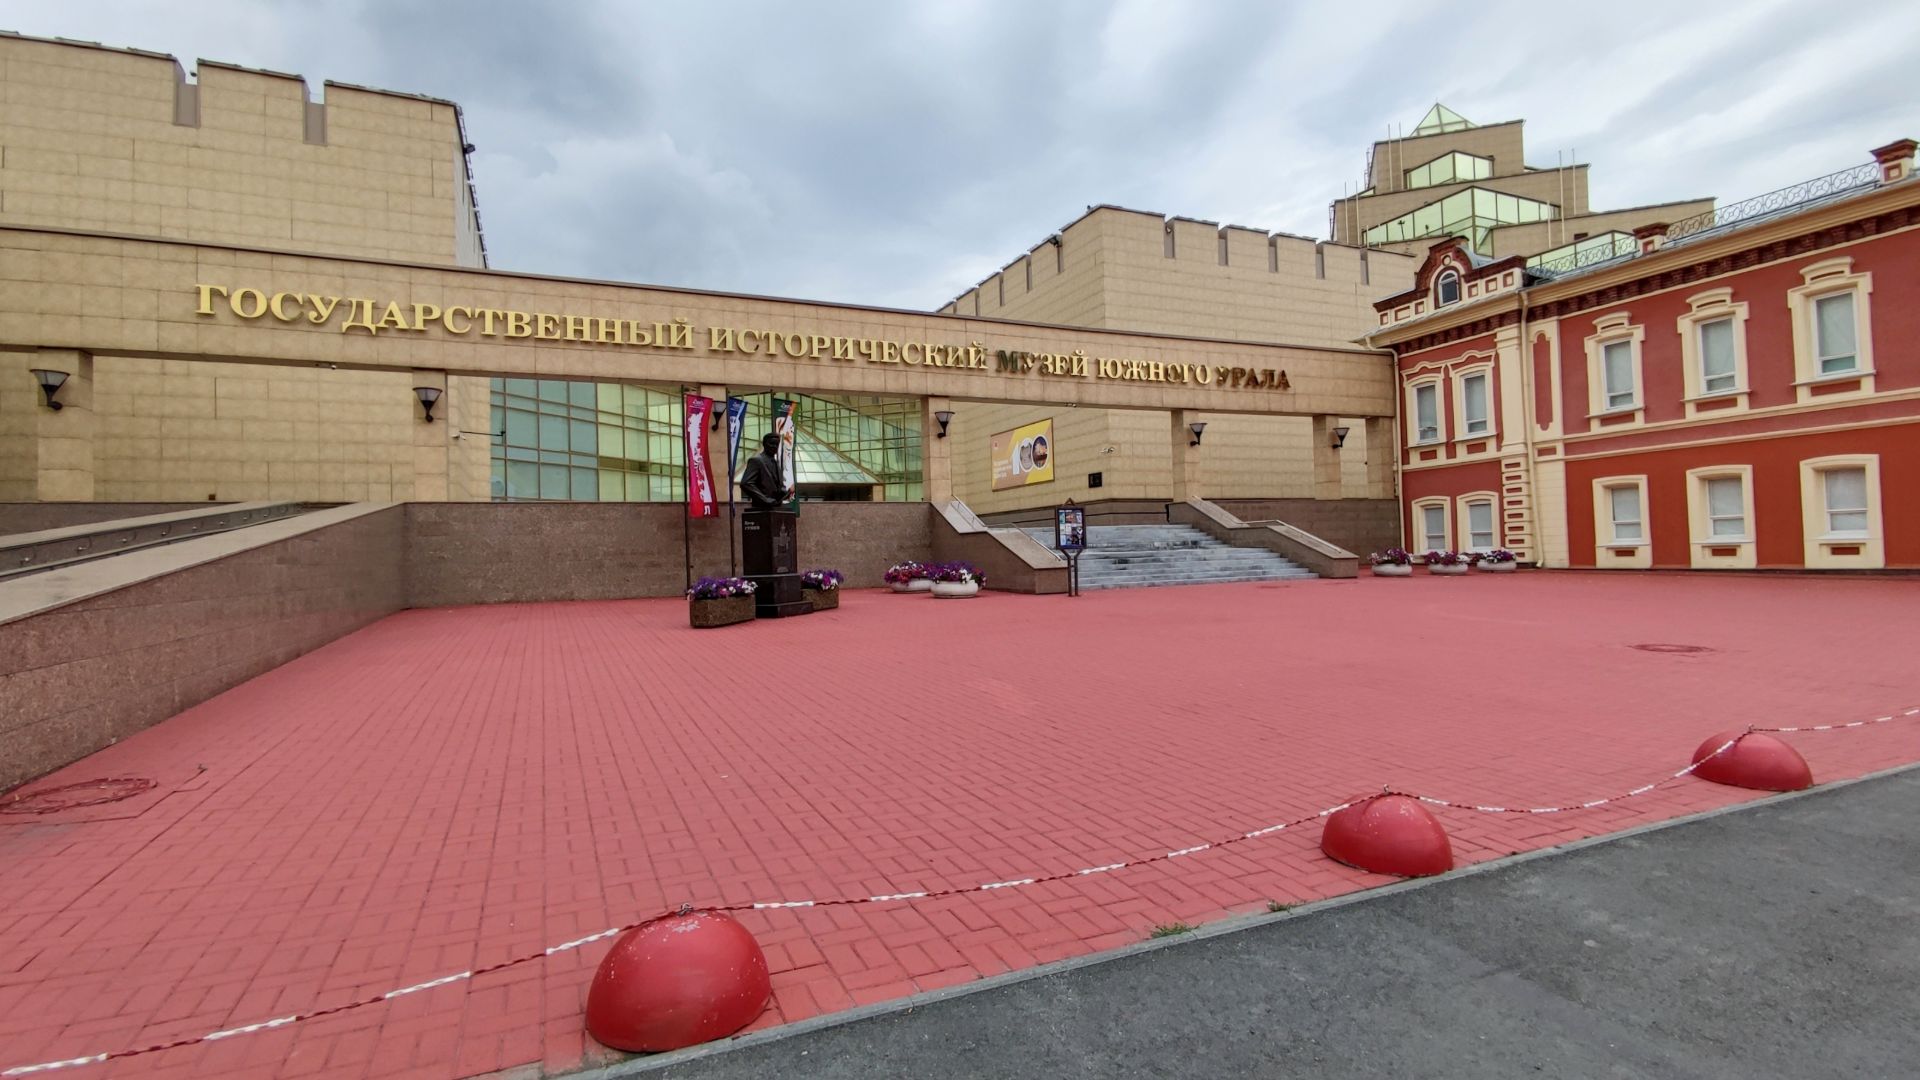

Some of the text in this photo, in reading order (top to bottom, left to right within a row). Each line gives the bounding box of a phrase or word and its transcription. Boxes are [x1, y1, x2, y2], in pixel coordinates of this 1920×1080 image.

[195, 283, 1291, 391] ГОСУДАРСТВЕННЫЙ ИСТОРИЧЕСКИЙ МУЗЕЙ ЮЖНОГО УРАЛА
